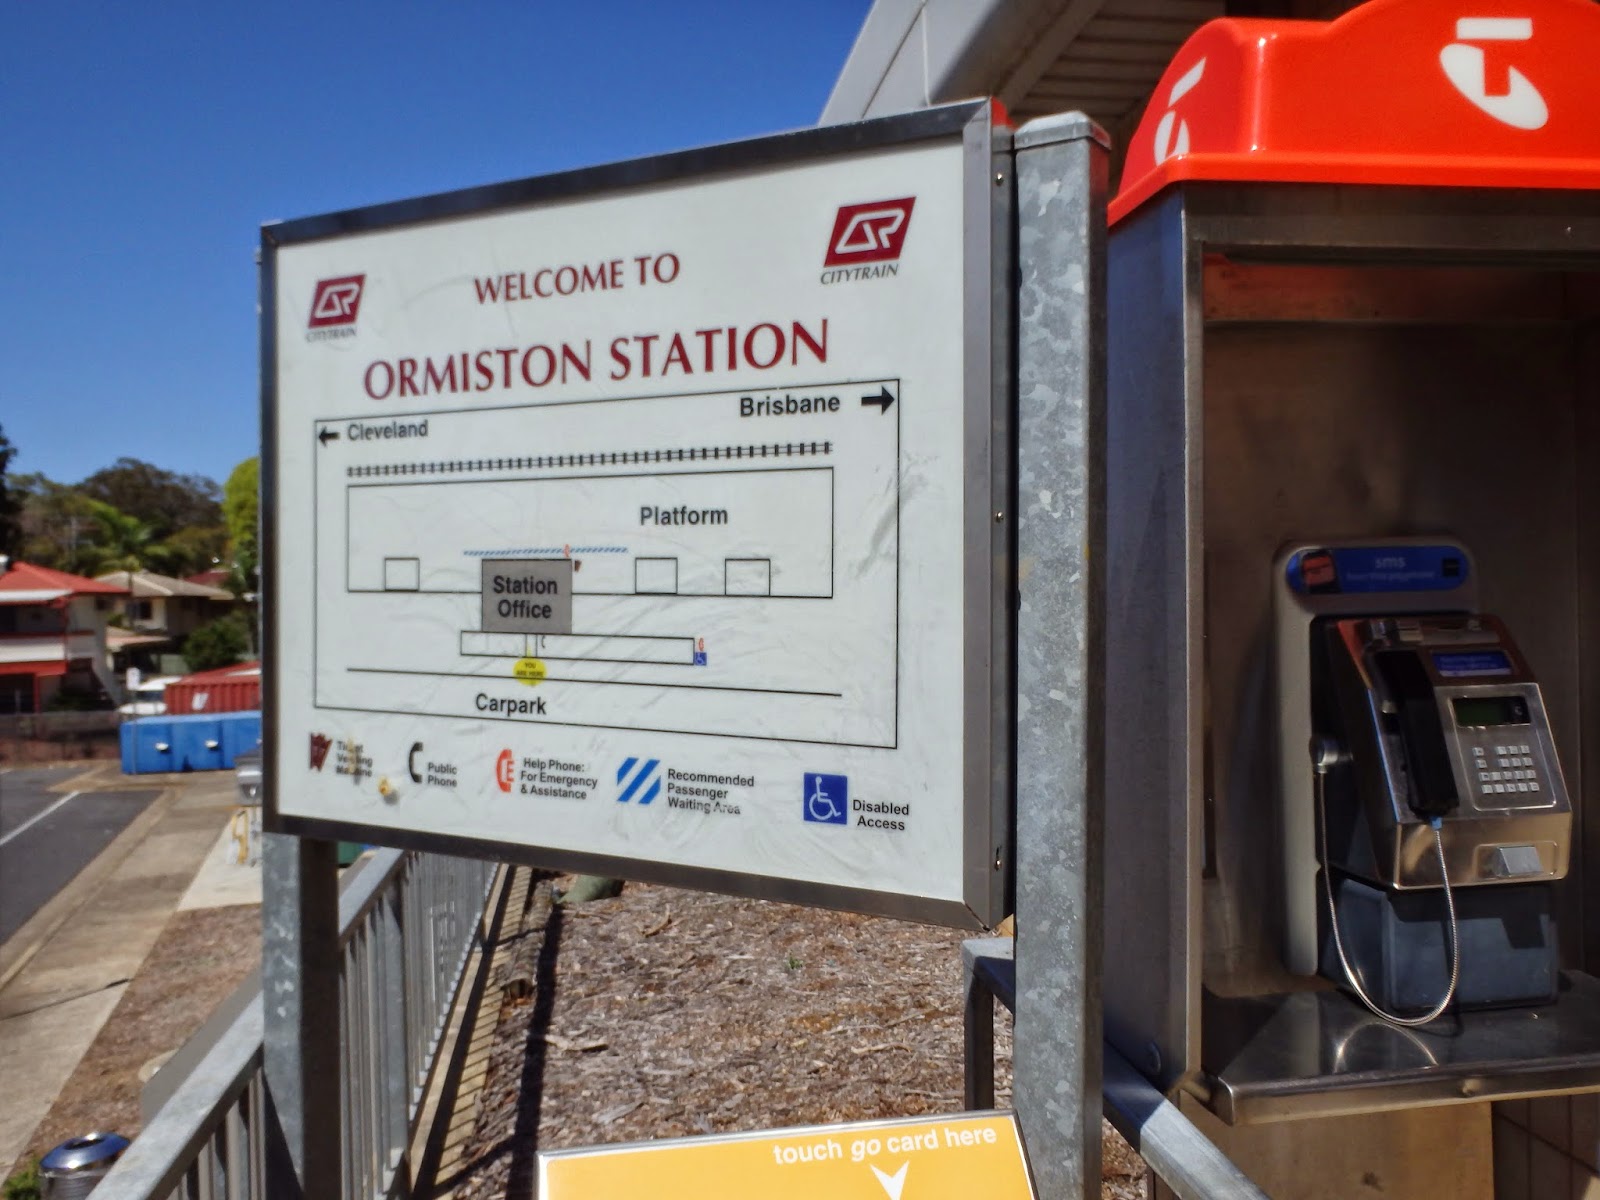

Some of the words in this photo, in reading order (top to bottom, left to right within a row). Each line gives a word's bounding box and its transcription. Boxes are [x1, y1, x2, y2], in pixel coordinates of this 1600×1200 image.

[474, 259, 624, 305] WELCOME
[634, 253, 681, 286] TO
[820, 263, 899, 285] CITYTRAIN
[364, 340, 593, 400] ORMISTON
[609, 318, 829, 382] STATION
[740, 393, 841, 417] Brisbane
[347, 419, 429, 441] Cleveland
[640, 506, 729, 526] Platform
[493, 575, 558, 596] Station
[497, 599, 552, 619] Office
[475, 693, 547, 718] Carpark
[427, 762, 458, 775] Public
[523, 757, 547, 770] Help
[549, 760, 585, 772] Phone:
[427, 774, 458, 788] Phone
[520, 771, 537, 782] For
[539, 774, 599, 790] Emergency
[668, 769, 755, 788] Recommended
[520, 785, 528, 795] &
[530, 785, 587, 799] Assistance
[667, 783, 729, 800] Passenger
[668, 797, 711, 814] Waiting
[713, 803, 741, 815] Area
[852, 799, 910, 816] Disabled
[857, 815, 905, 831] Access
[773, 1140, 843, 1165] touch
[850, 1139, 883, 1163] go
[886, 1130, 939, 1155] card
[945, 1126, 997, 1149] here
